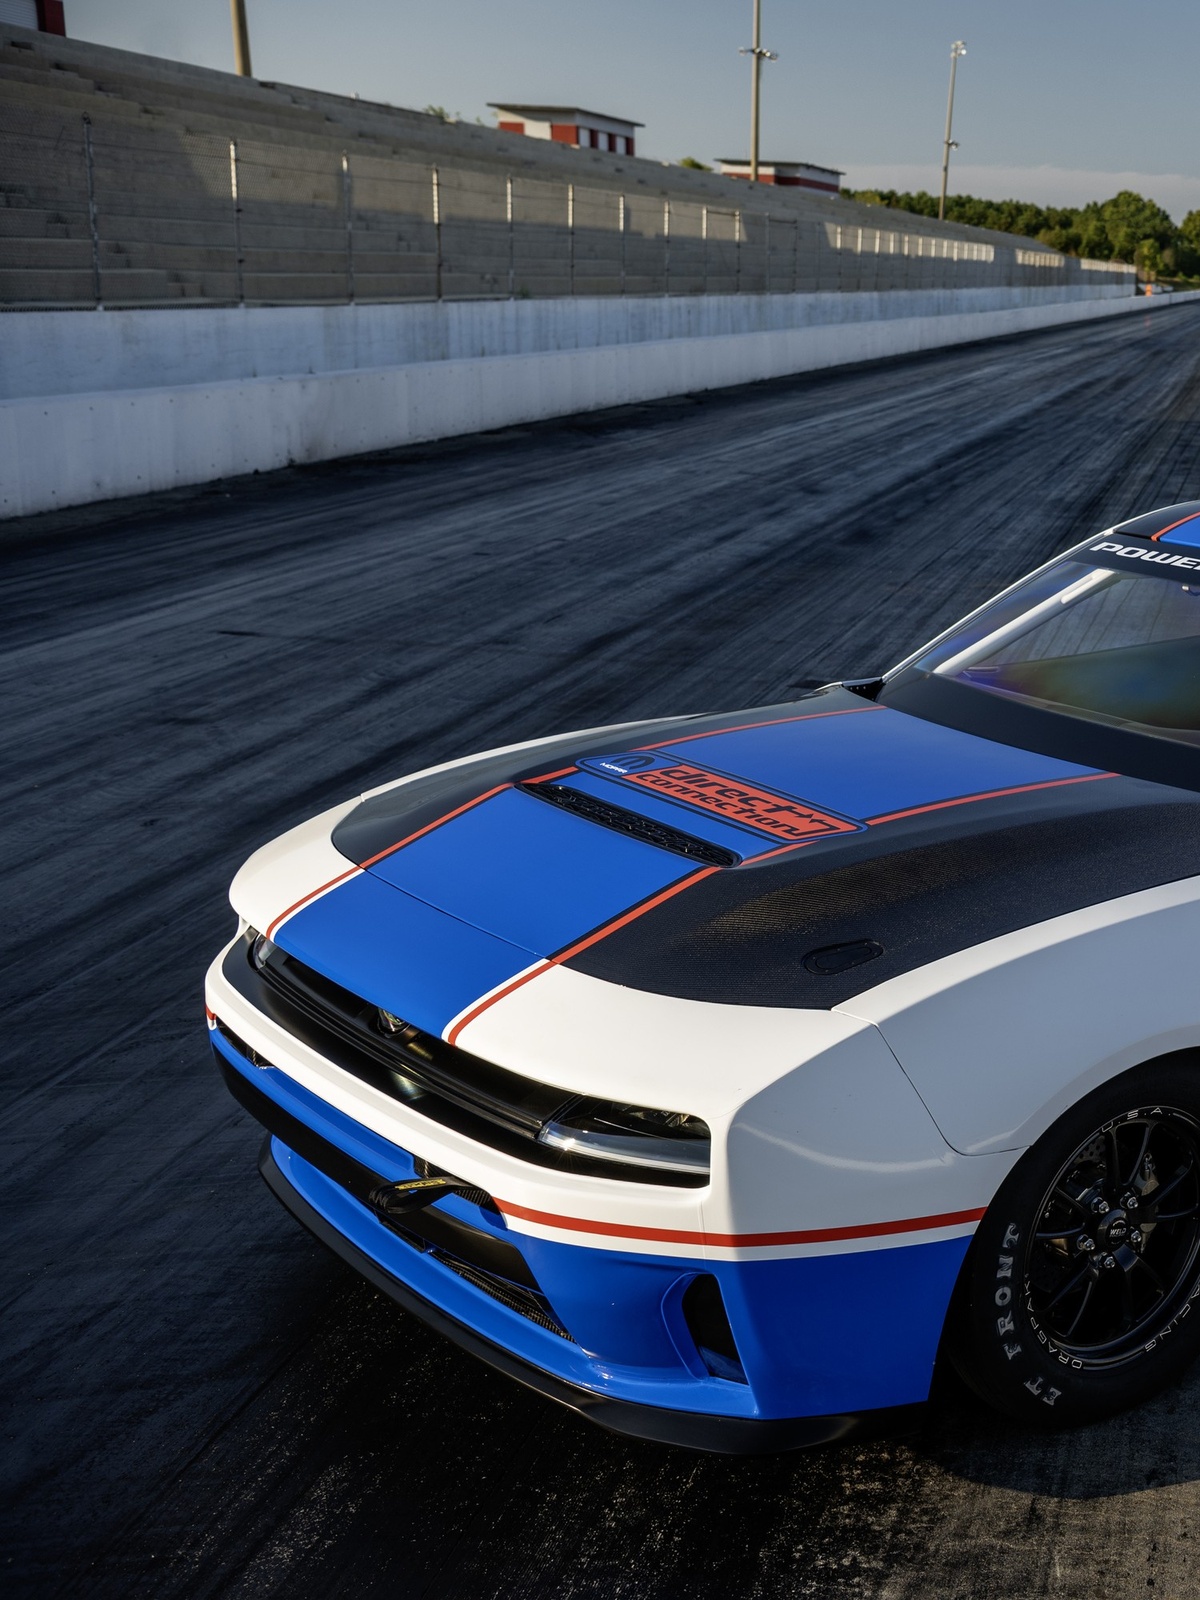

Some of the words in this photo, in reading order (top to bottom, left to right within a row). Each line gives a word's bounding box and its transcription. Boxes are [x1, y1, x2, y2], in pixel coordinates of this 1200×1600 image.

[636, 774, 804, 837] connection
[660, 768, 798, 815] direct
[994, 1222, 1022, 1360] FRONT
[1023, 1375, 1062, 1406] ET
